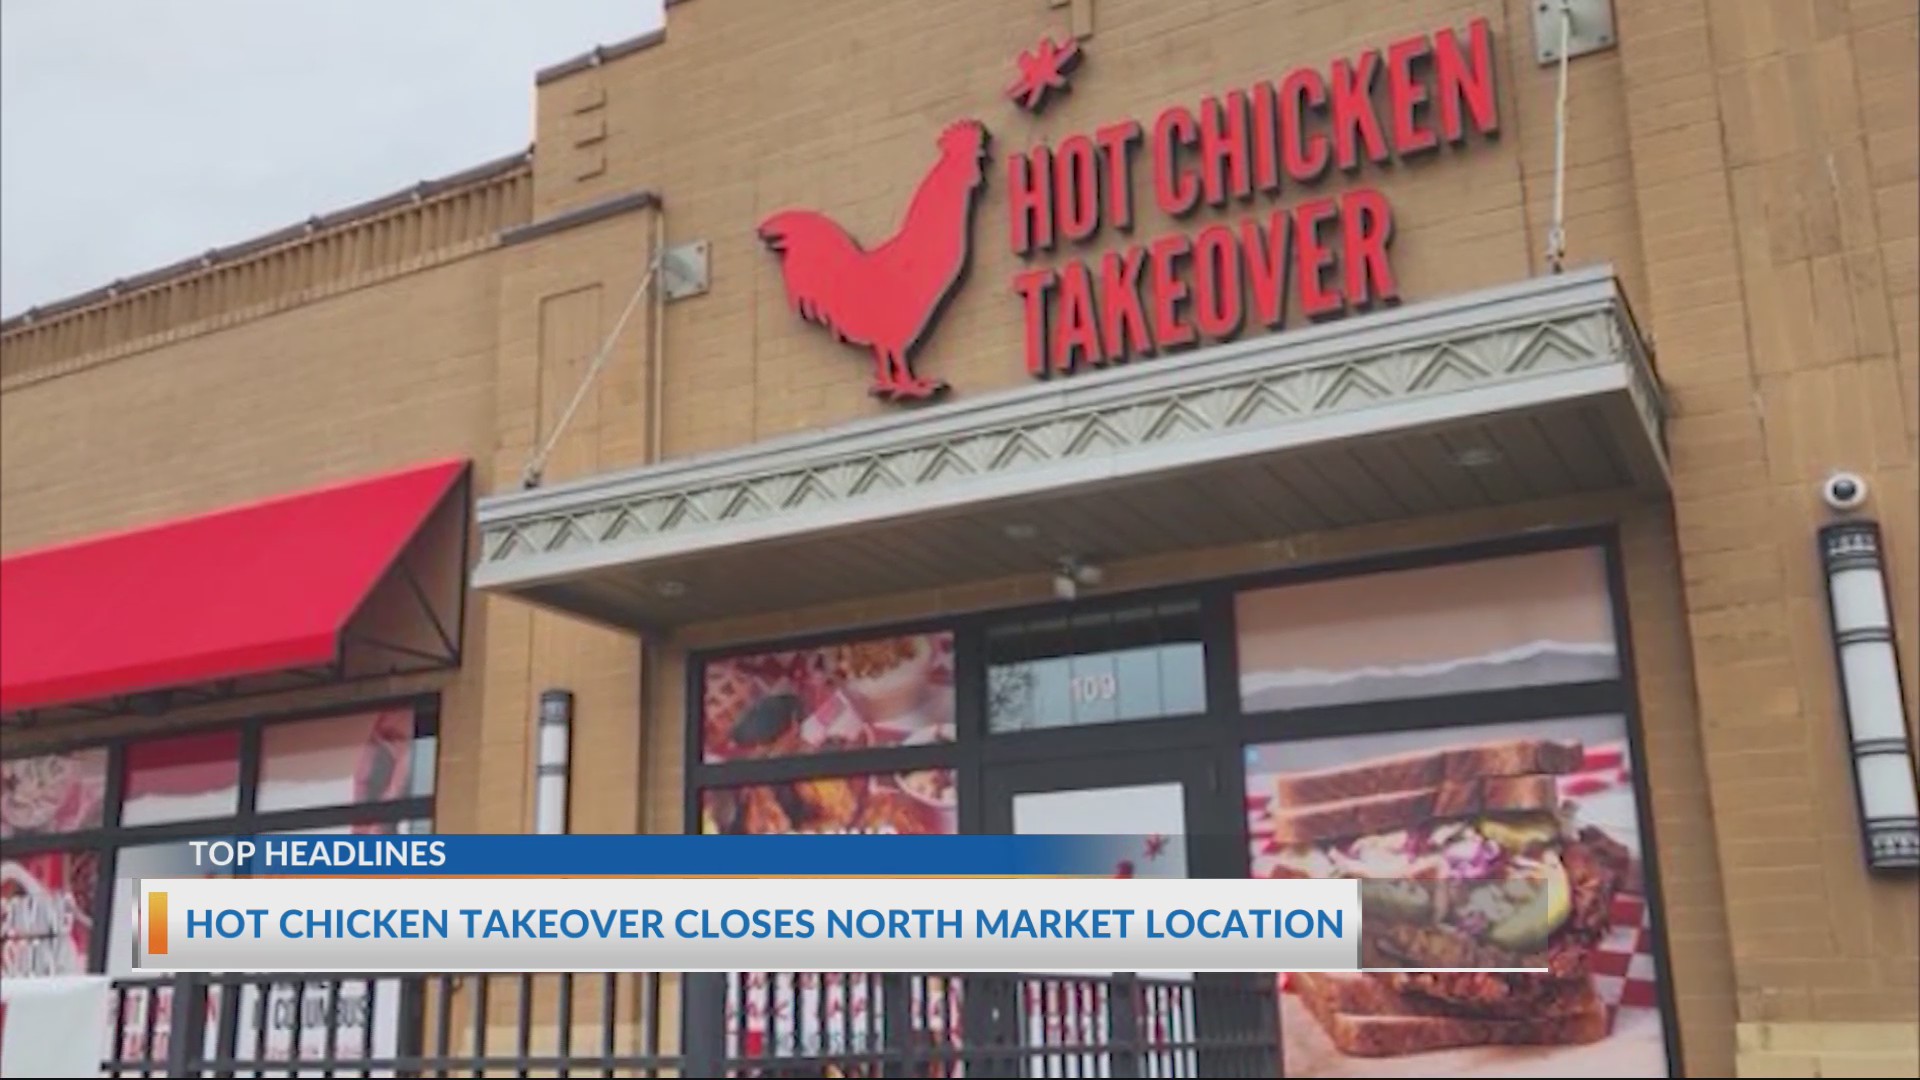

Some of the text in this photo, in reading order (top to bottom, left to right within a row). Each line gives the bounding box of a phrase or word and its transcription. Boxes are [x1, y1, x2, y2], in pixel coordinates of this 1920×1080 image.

[1008, 18, 1499, 255] HOT CHICKEN
[1012, 188, 1400, 376] TAKEOVER
[1071, 673, 1116, 701] 109
